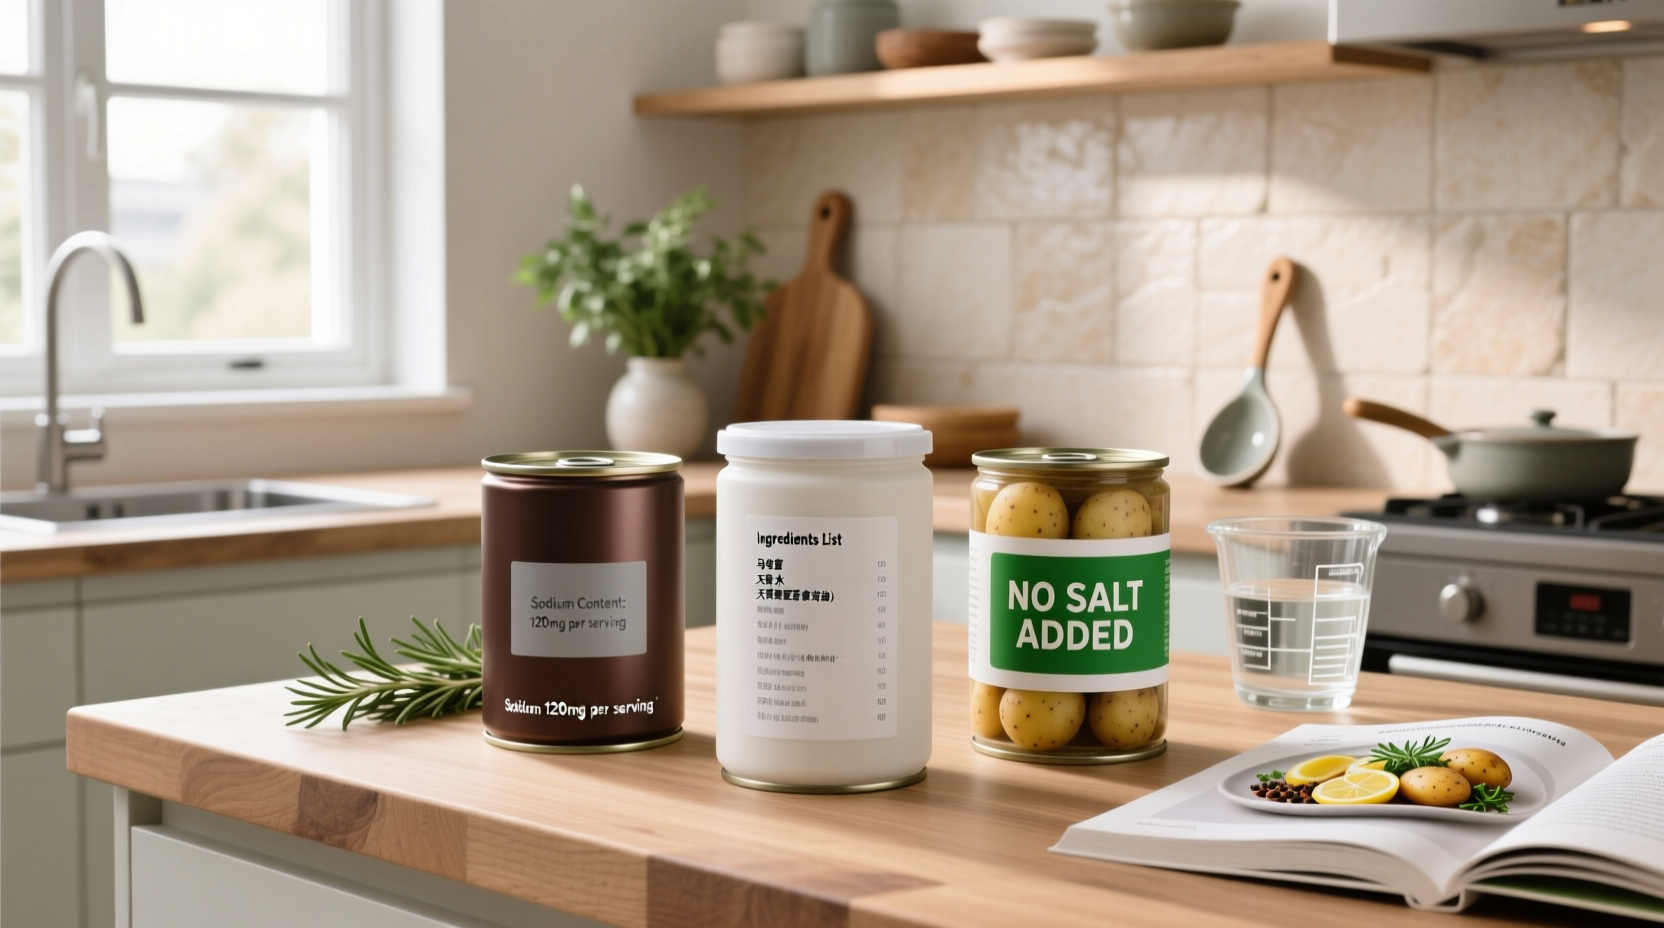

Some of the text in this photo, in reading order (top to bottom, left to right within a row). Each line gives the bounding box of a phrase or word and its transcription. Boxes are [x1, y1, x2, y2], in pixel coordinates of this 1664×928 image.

[757, 531, 842, 548] Ingredients List
[530, 596, 626, 610] Sodium Content:
[1008, 579, 1144, 613] NO SALT
[530, 615, 626, 633] 120mg per serving
[1015, 618, 1134, 651] ADDED
[544, 701, 586, 721] 120mg
[590, 704, 609, 720] per
[613, 698, 654, 716] serving
